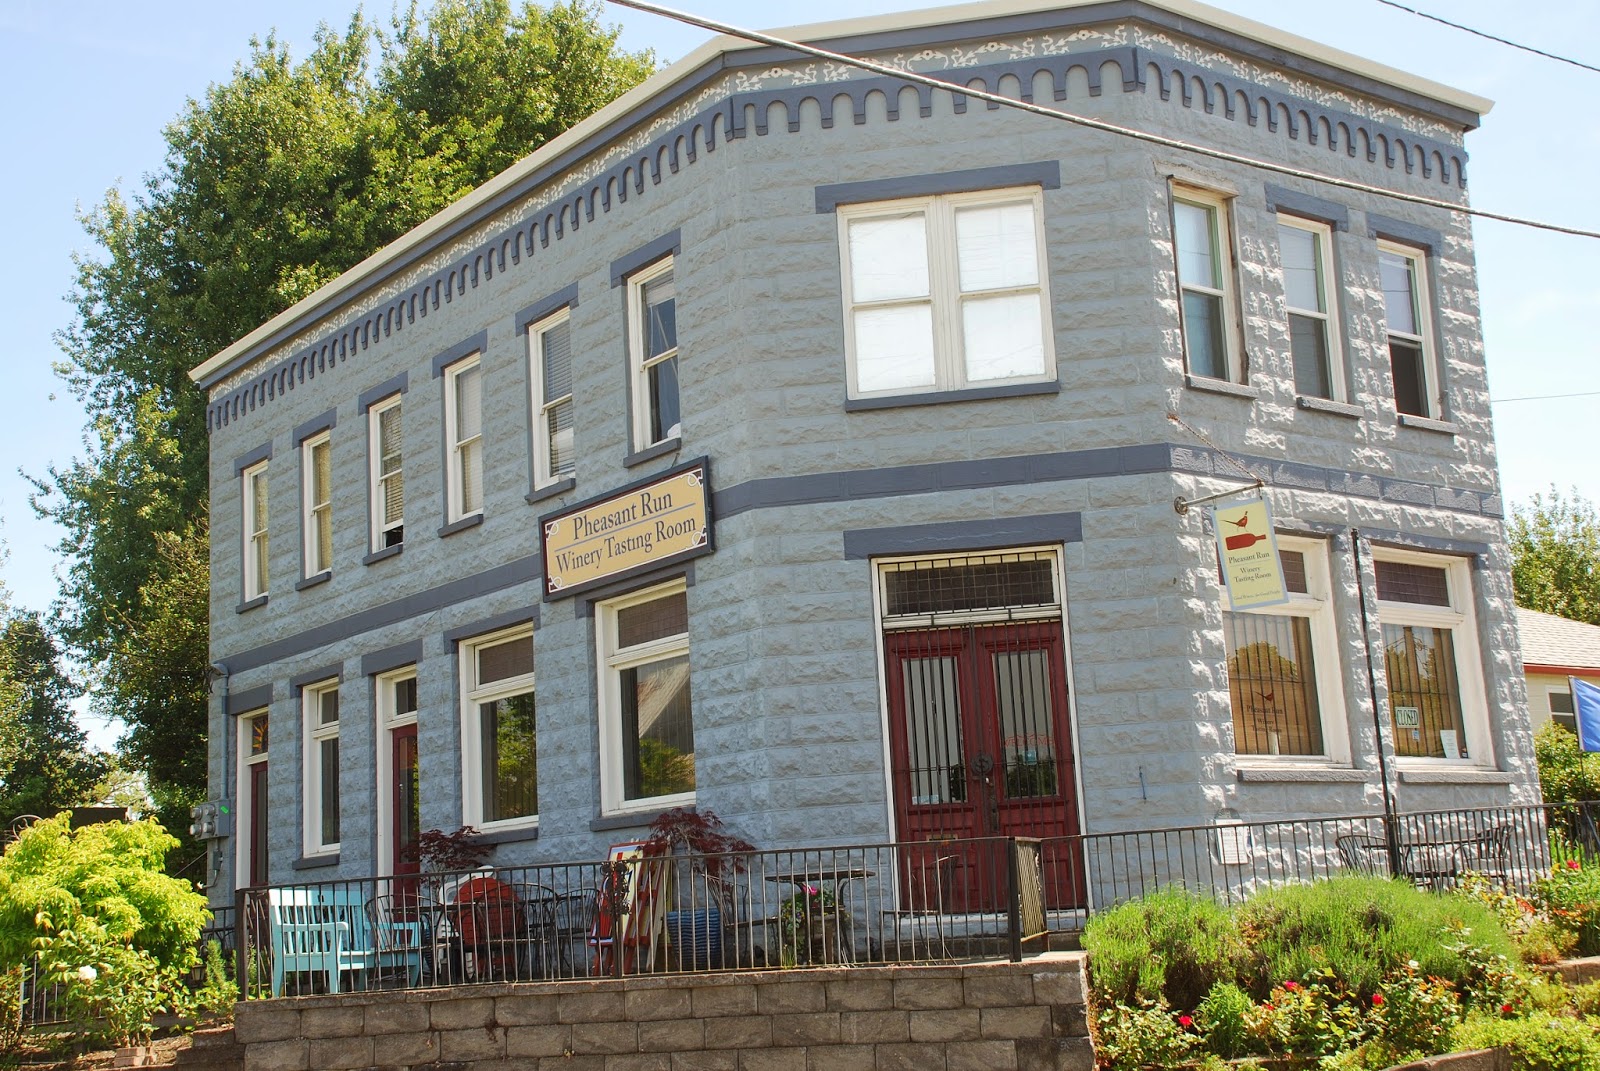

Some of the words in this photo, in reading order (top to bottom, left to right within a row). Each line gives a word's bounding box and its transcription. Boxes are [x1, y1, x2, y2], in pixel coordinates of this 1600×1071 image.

[573, 502, 637, 541] Pheasant
[640, 492, 673, 517] Run
[555, 548, 603, 574] Winery
[604, 532, 652, 559] Tasting
[655, 517, 696, 542] Room
[1228, 555, 1255, 564] Pheasant
[1256, 551, 1270, 559] Run
[1234, 575, 1255, 583] Tasting
[1397, 710, 1418, 725] CLOSED
[1004, 736, 1056, 748] WELOME
